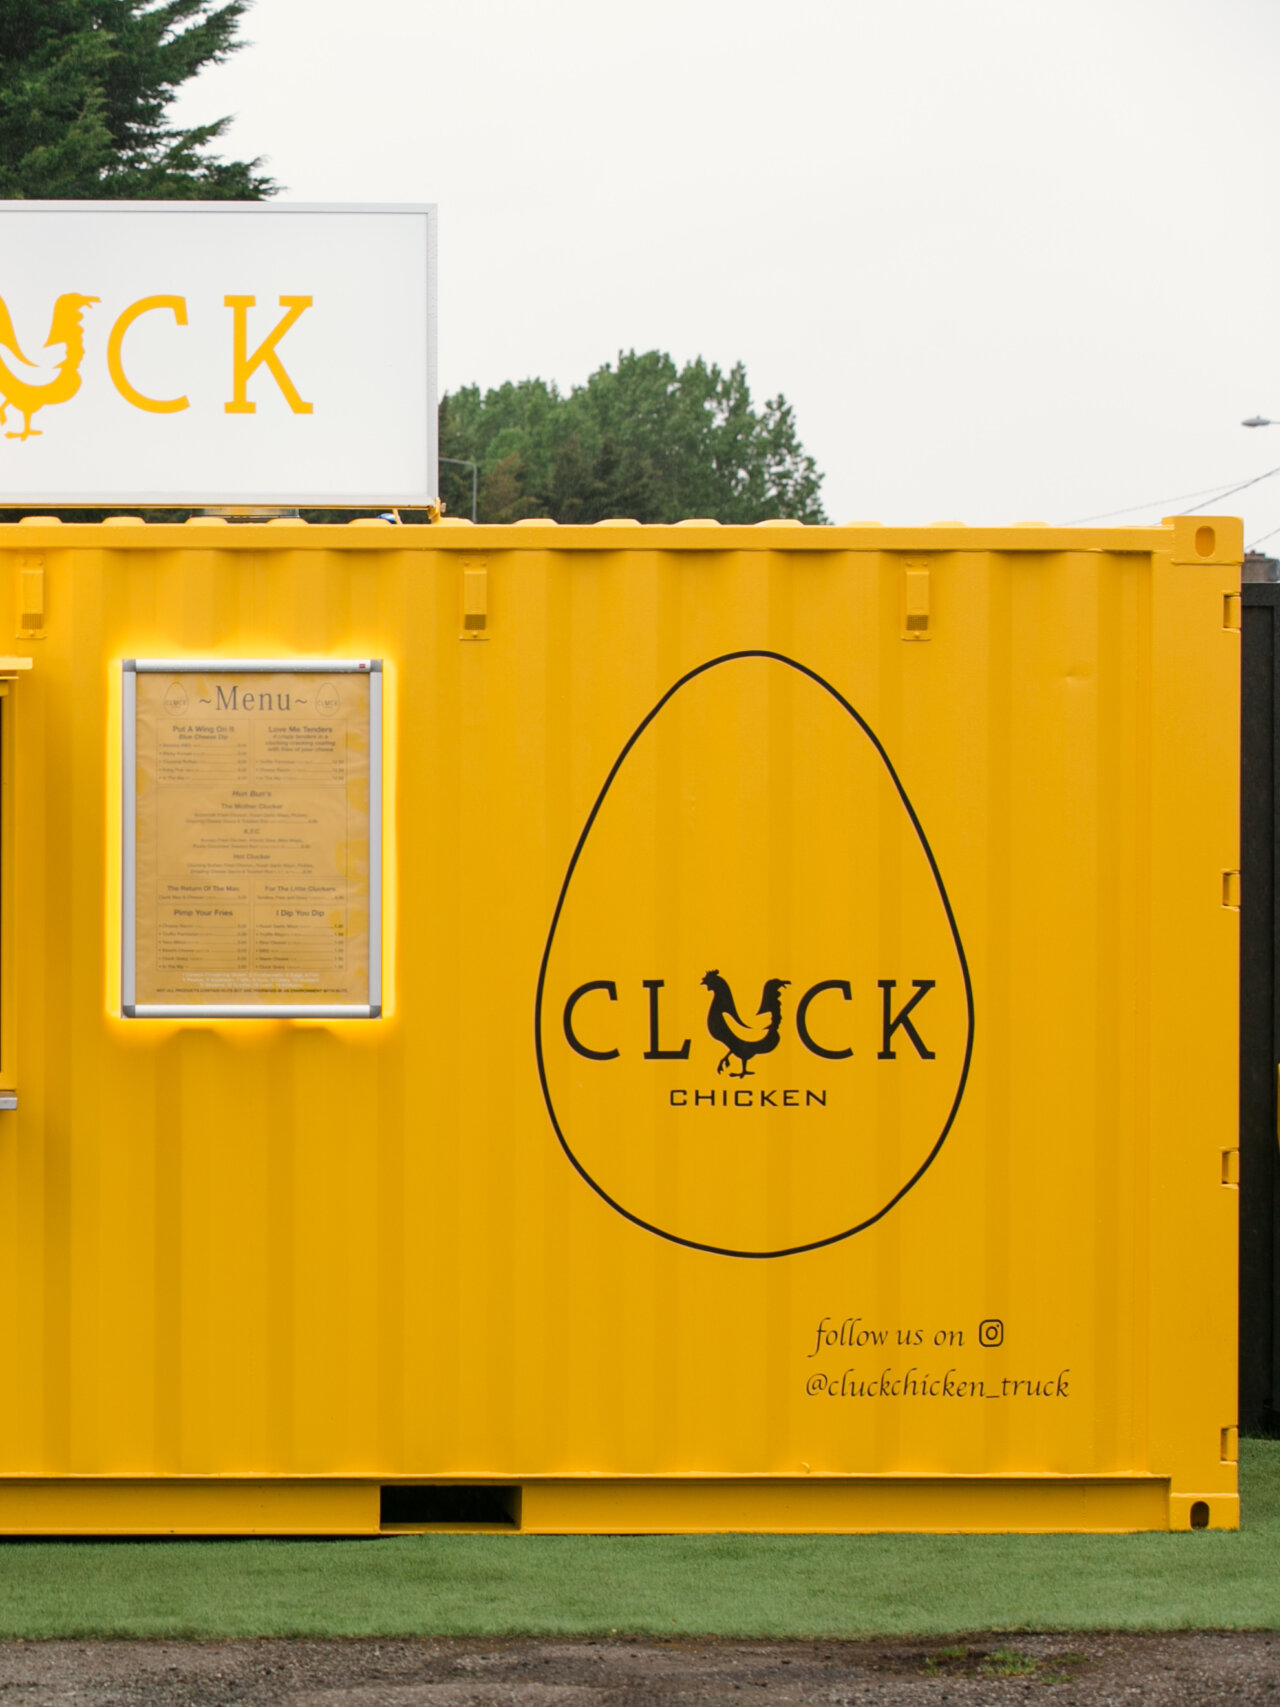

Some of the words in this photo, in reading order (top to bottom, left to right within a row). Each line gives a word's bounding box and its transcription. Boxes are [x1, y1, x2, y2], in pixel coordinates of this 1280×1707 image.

[172, 725, 186, 733] Put
[187, 725, 194, 733] A
[194, 725, 215, 734] Wing
[215, 725, 228, 733] On
[173, 909, 193, 917] Pimp
[195, 909, 212, 917] Your
[214, 909, 233, 917] Fries
[280, 909, 294, 917] Dip
[311, 909, 325, 917] Dip
[562, 969, 936, 1080] CLUCK
[670, 1089, 828, 1107] CHICKEN
[807, 1317, 888, 1358] follow
[897, 1329, 924, 1346] us
[933, 1330, 964, 1347] on
[806, 1367, 1070, 1399] @cluckchicken_truck
